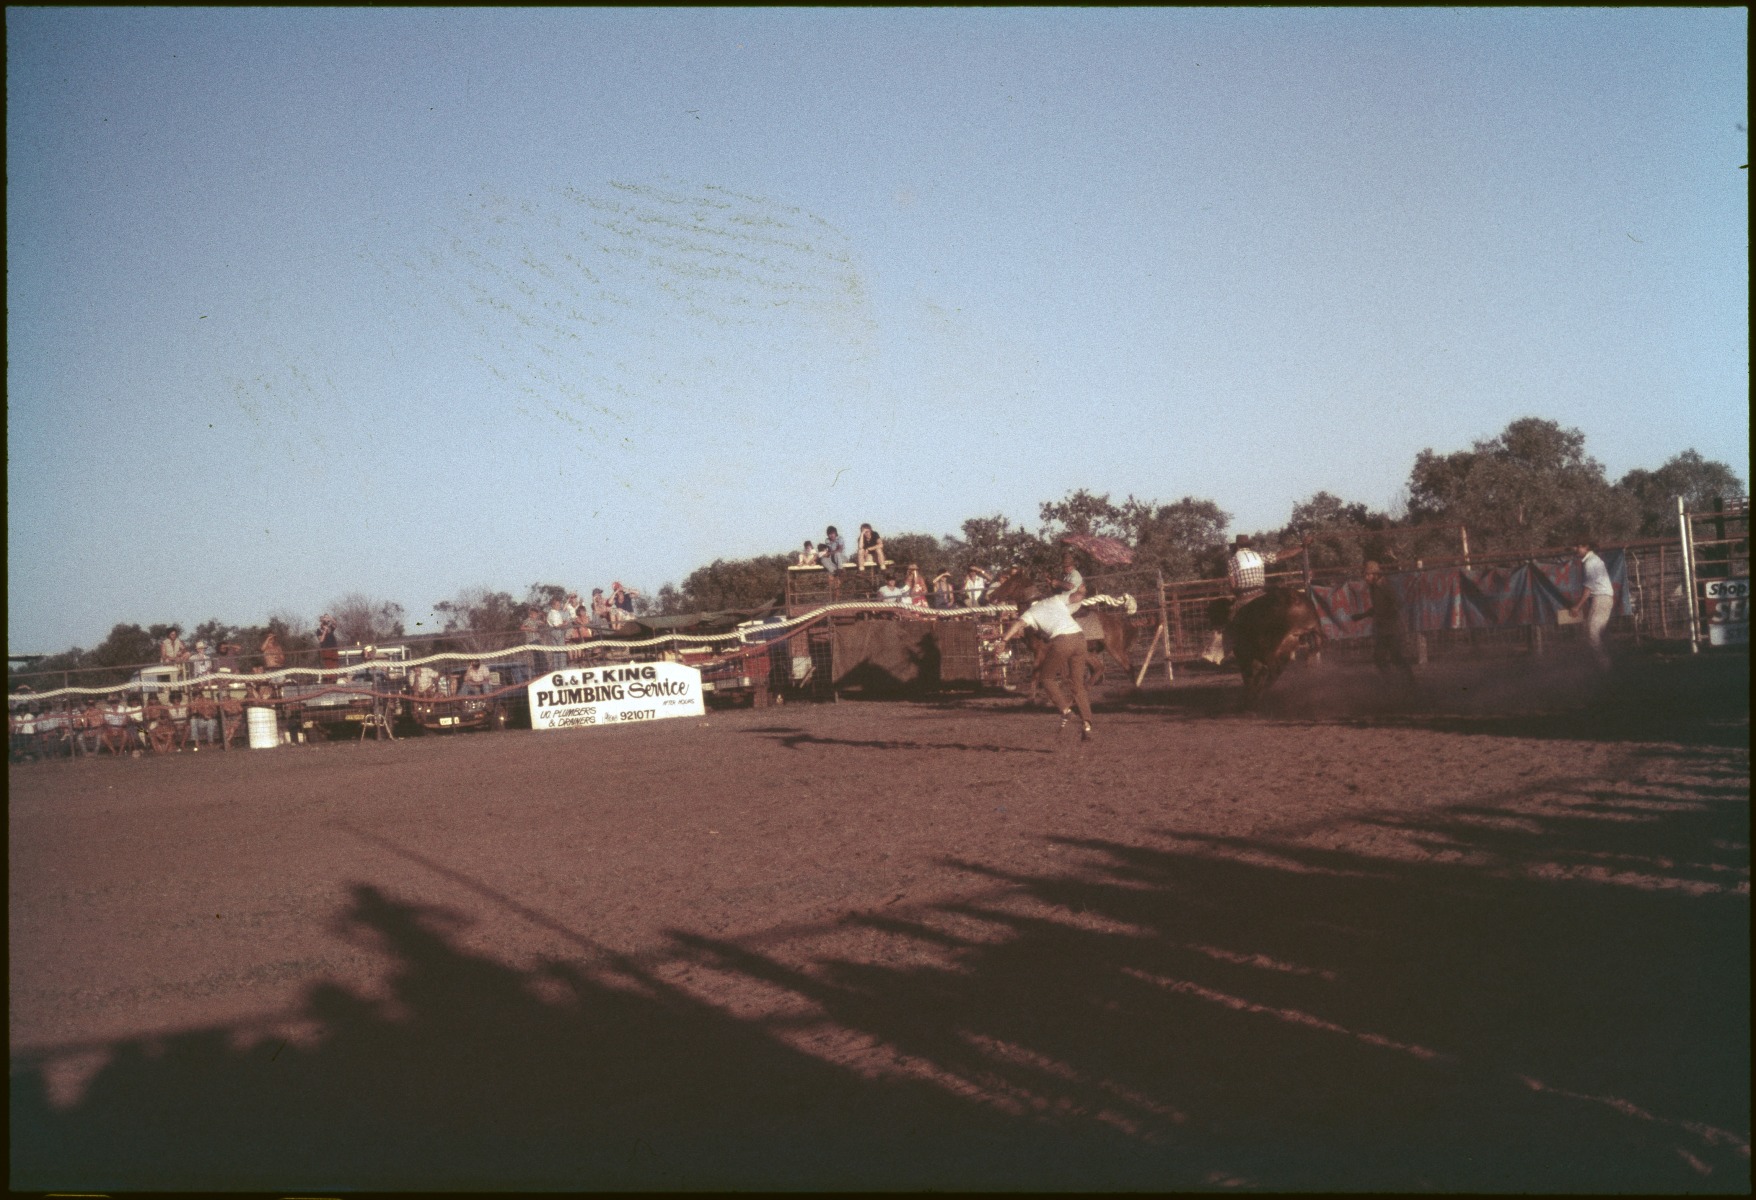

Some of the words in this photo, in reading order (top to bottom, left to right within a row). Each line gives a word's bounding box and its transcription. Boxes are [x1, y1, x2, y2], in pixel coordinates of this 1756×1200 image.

[1709, 583, 1746, 596] Shop
[552, 674, 569, 687] G.
[570, 675, 579, 685] &
[582, 672, 598, 684] P.
[602, 666, 657, 682] KING
[537, 684, 624, 707] PLUMBING
[627, 678, 690, 699] Service
[552, 706, 597, 718] PLUMBERS
[620, 709, 656, 721] 921077
[548, 718, 556, 728] &
[557, 715, 596, 727] DRAINERS
